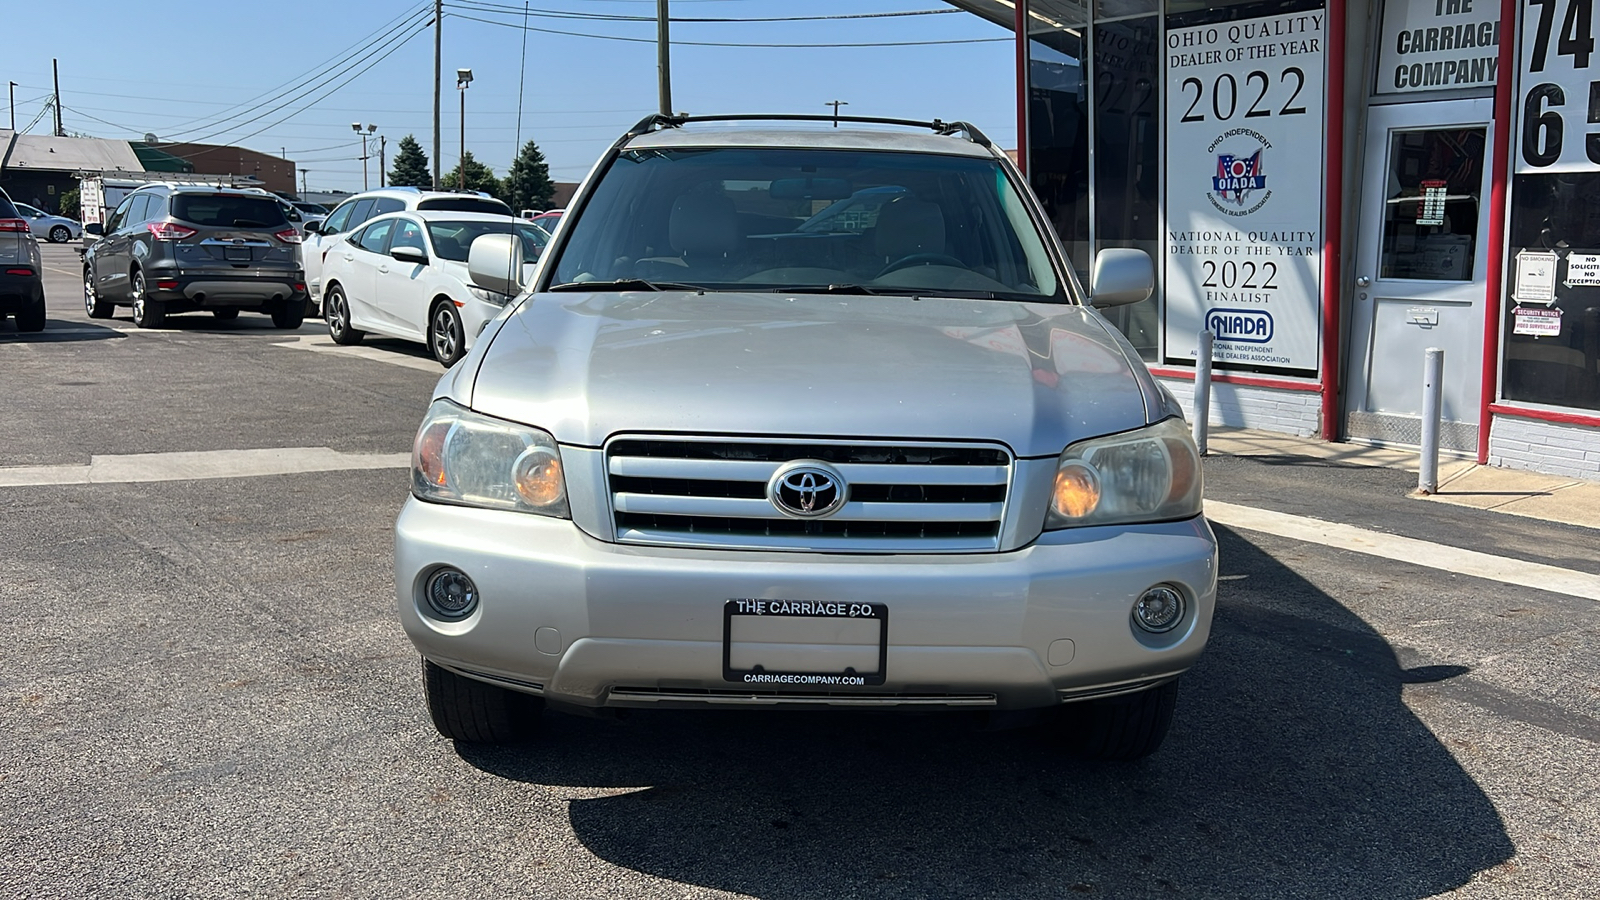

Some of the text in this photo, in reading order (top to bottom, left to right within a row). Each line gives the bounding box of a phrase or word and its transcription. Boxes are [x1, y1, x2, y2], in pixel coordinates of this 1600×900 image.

[1435, 0, 1472, 16] THE
[1168, 14, 1323, 49] OHIO QUALITY
[1528, 0, 1595, 73] 74
[1170, 50, 1222, 68] DEALER
[1225, 47, 1244, 62] OF
[1247, 43, 1276, 60] THE
[1280, 38, 1319, 56] YEAR
[1394, 56, 1499, 88] COMPANY
[1180, 66, 1306, 123] 2022
[1207, 127, 1273, 153] OHIO INDEPENDENT
[1218, 177, 1257, 190] OIADA
[1206, 189, 1273, 217] AUTOMOBILE DEALERS ASSOCIATION
[1169, 231, 1316, 243] NATIONAL QUALITY
[1170, 245, 1313, 257] DEALER OF THE YEAR
[1201, 260, 1278, 290] 2022
[1206, 291, 1271, 303] FINALIST
[1210, 315, 1267, 337] NIADA
[1212, 343, 1274, 353] TIONAL INDEPENDENT
[1225, 352, 1250, 361] DEALERS
[1250, 355, 1291, 364] ASSOCIATION
[736, 600, 876, 617] THE CARRIAGE CO.
[743, 674, 865, 686] CARRIAGECOMPANY.COM
